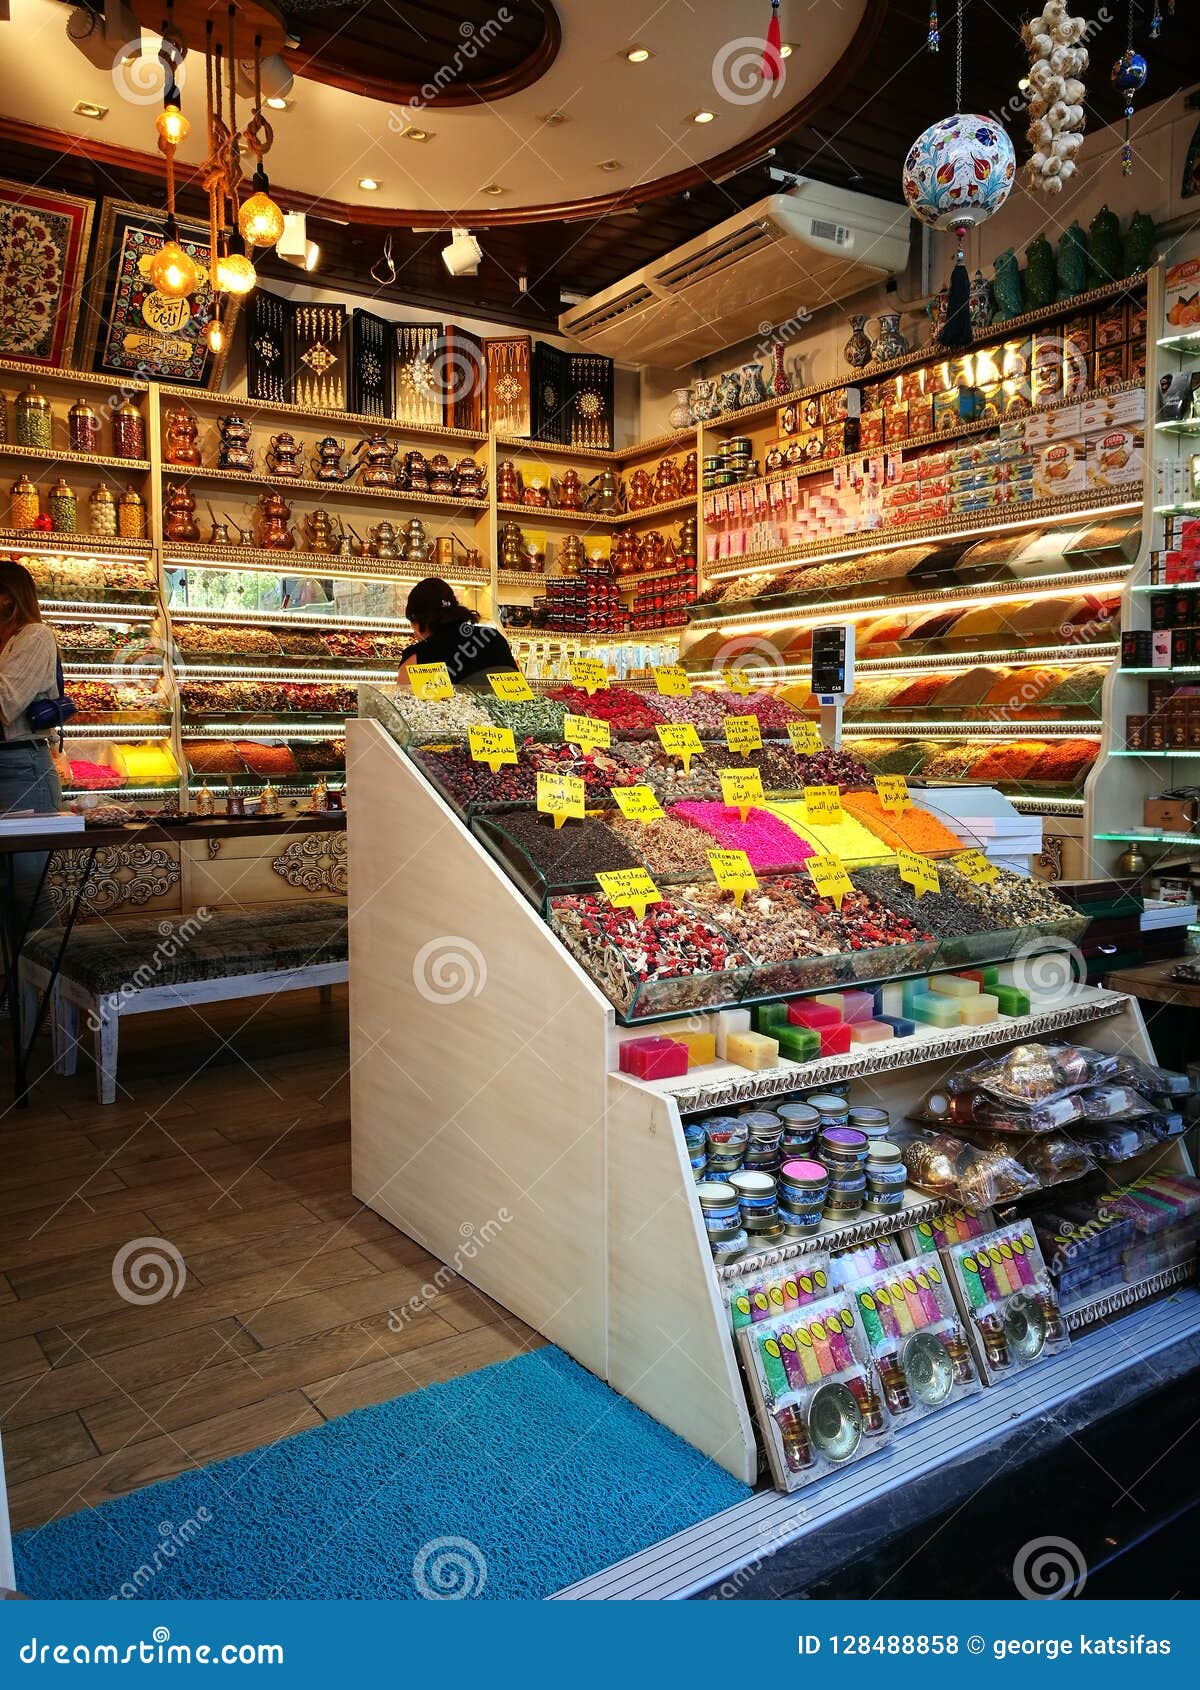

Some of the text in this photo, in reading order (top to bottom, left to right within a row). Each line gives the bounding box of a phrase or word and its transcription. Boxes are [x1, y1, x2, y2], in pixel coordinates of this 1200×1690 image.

[489, 675, 519, 683] Melissa
[576, 724, 590, 734] Tea
[470, 728, 503, 742] Rosehip
[539, 773, 583, 789] Black Tea
[827, 788, 837, 797] Tea
[709, 851, 743, 861] Ottoman
[898, 850, 937, 872] Green Tea
[807, 857, 836, 869] Love Tea
